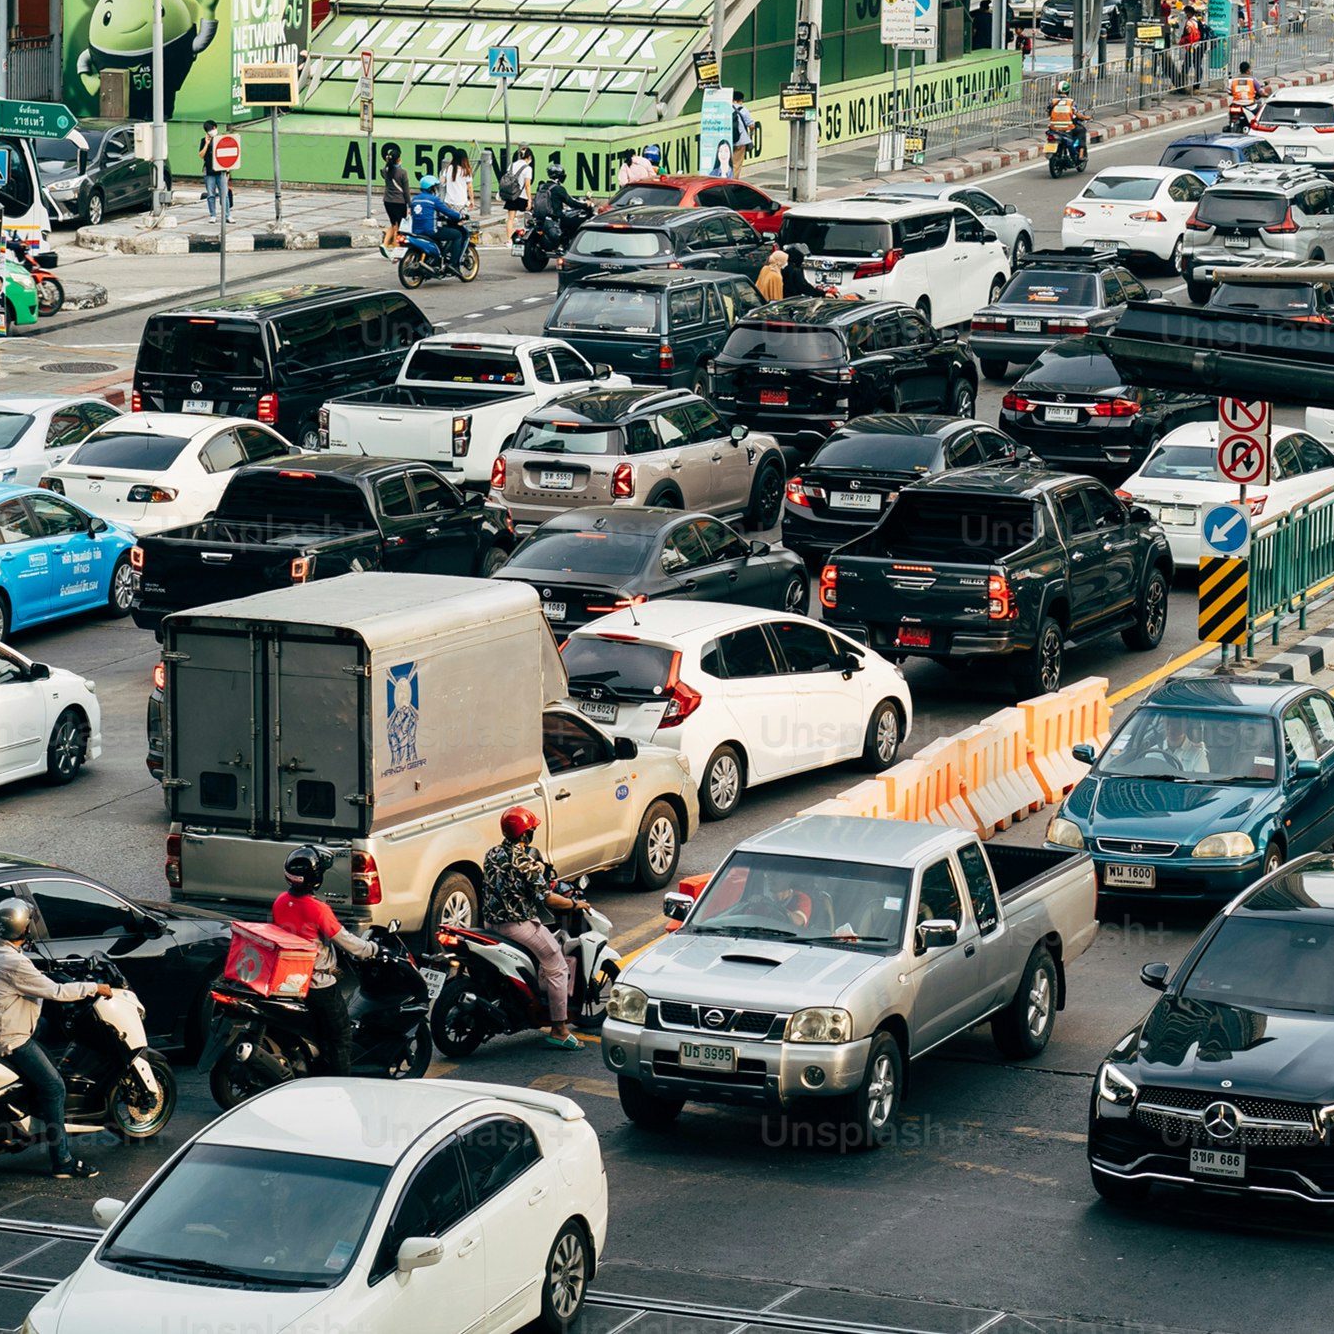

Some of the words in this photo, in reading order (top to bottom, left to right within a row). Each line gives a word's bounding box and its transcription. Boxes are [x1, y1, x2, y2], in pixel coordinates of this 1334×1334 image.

[233, 19, 287, 54] NETWORK
[330, 19, 666, 60] NETWORK
[133, 72, 153, 92] 5G
[825, 102, 842, 142] 5G
[848, 96, 875, 136] NO.1
[878, 80, 937, 126] NETWORK
[941, 76, 954, 113] IN
[956, 65, 1011, 112] THAILAND
[13, 115, 45, 127] ราชเทวี
[758, 366, 787, 375] ISUZU
[380, 764, 407, 778] HANDY
[406, 757, 428, 772] GEAR
[1127, 868, 1152, 879] 1600
[1219, 1153, 1241, 1167] 686
